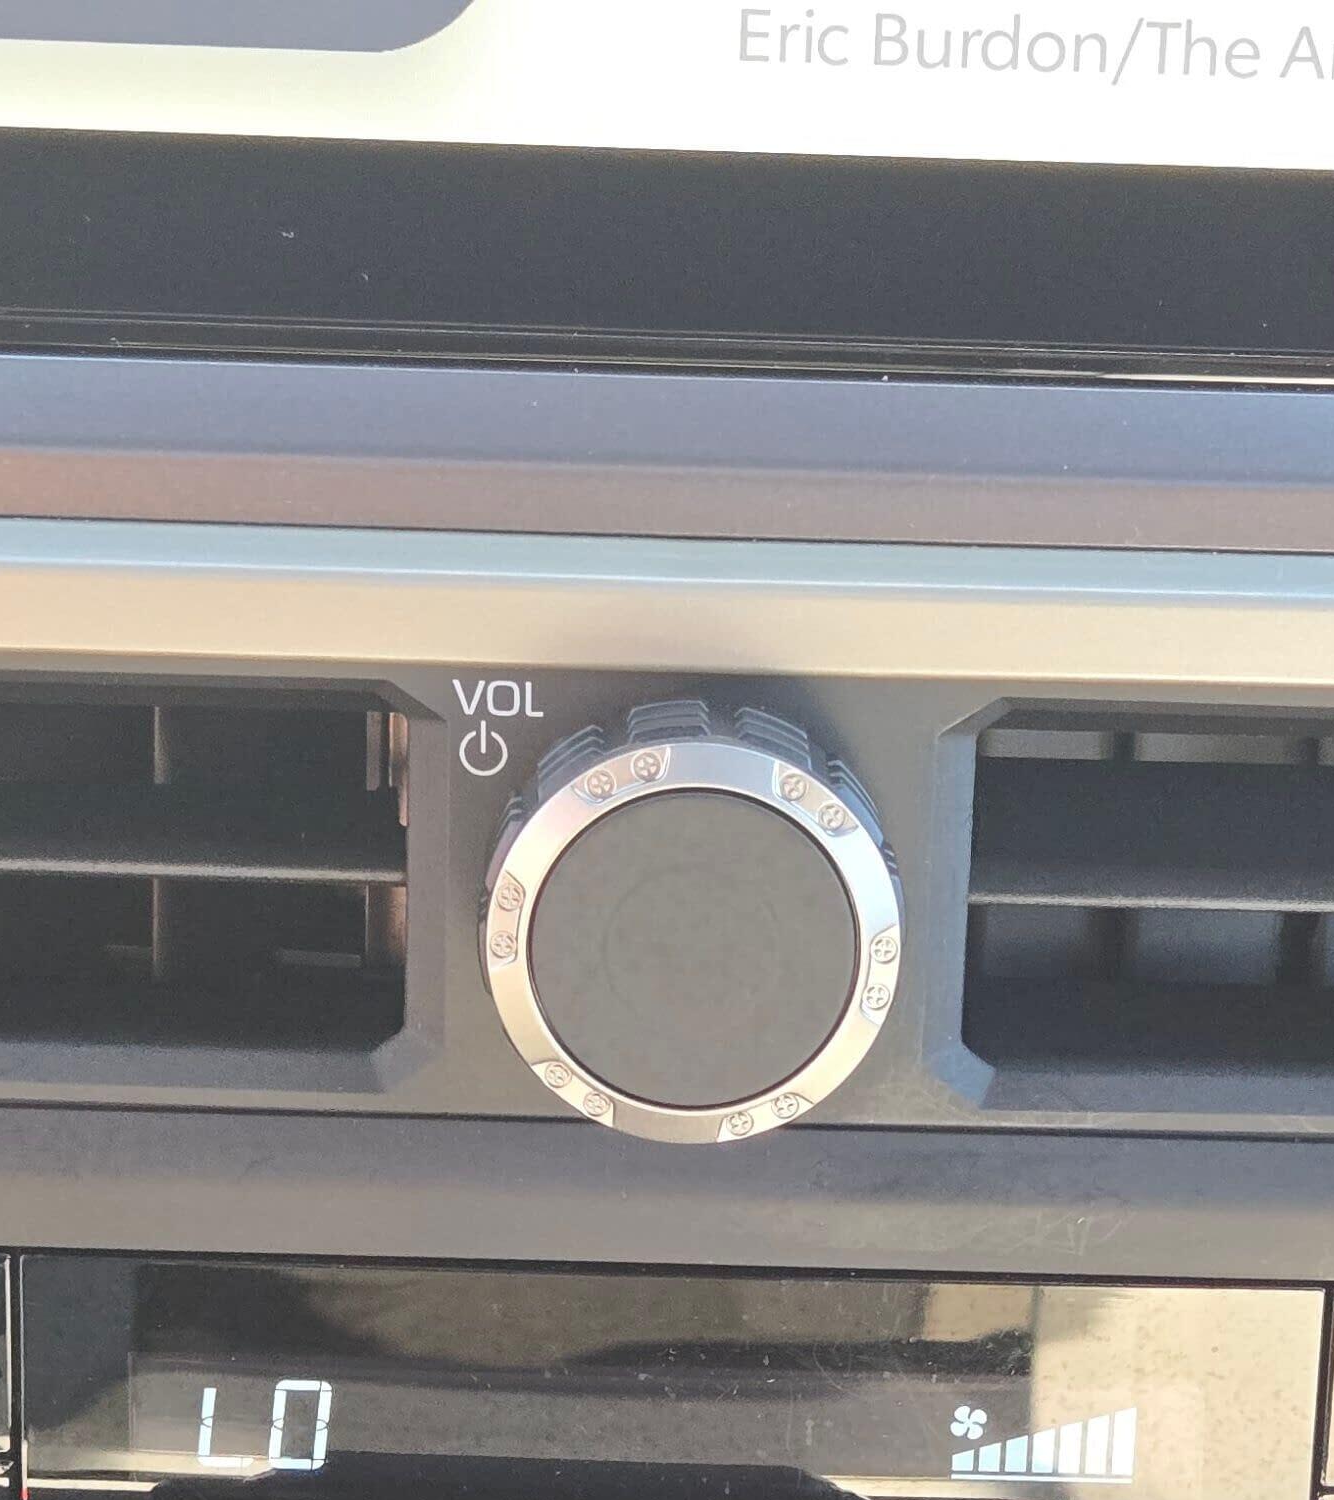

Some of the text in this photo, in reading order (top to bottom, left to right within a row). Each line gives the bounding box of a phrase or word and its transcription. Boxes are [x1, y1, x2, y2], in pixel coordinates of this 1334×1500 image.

[739, 8, 849, 66] Eric
[873, 12, 1261, 86] Burdon/The
[452, 678, 544, 718] VOL
[197, 1380, 332, 1469] LO
